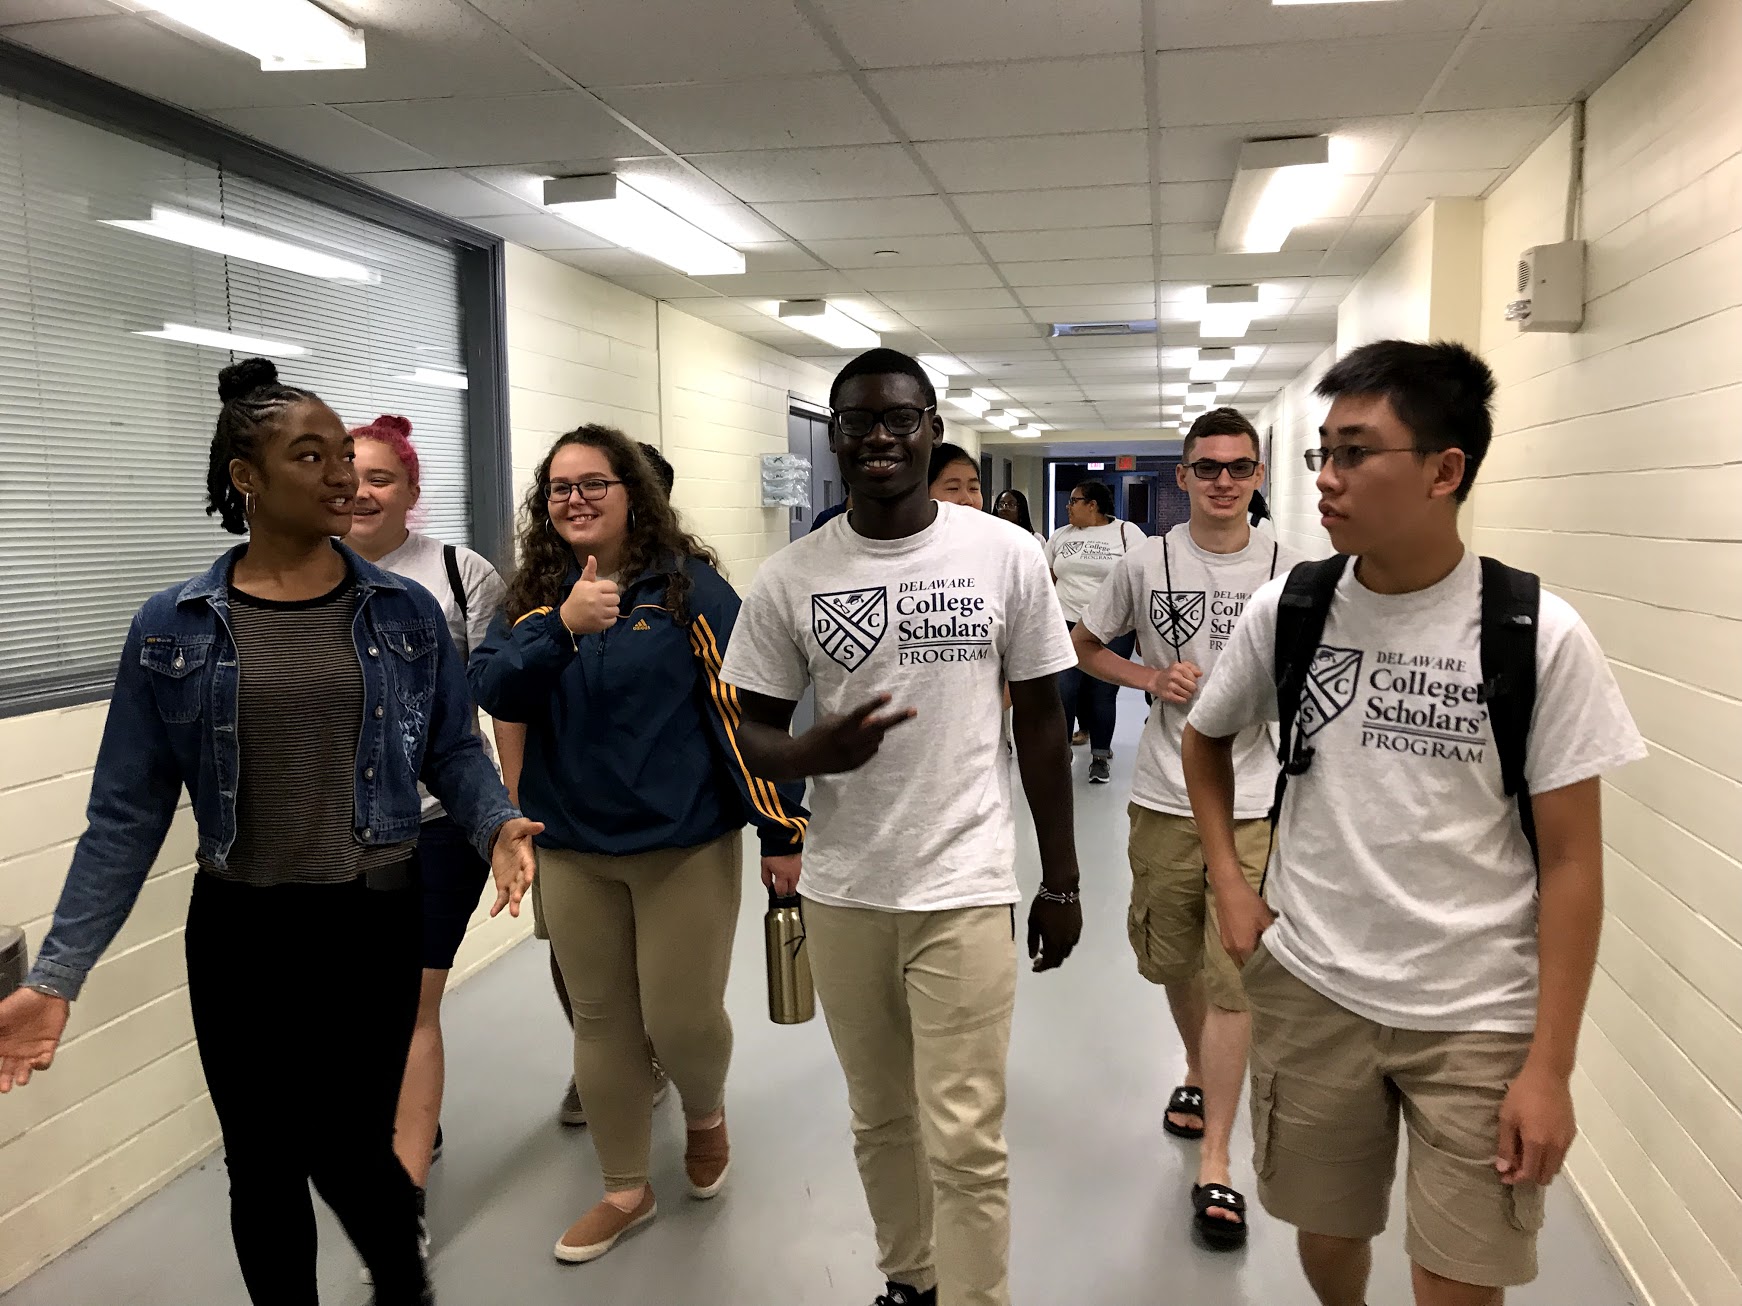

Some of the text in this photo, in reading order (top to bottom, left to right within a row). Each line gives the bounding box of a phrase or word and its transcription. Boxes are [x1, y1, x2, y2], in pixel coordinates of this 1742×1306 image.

[898, 577, 976, 593] DELAWARE
[896, 592, 984, 617] College
[1213, 590, 1252, 600] DELAWA
[1210, 600, 1244, 617] Coll
[817, 612, 880, 634] D C
[898, 616, 993, 641] Scholars'
[843, 644, 855, 659] S
[898, 648, 989, 665] PROGRAM
[1376, 651, 1467, 673] DELAWARE
[1334, 678, 1350, 694] C
[1369, 668, 1477, 707] College
[1302, 706, 1314, 723] S
[1364, 696, 1488, 735] Scholars'
[1361, 730, 1484, 764] PROGRAM
